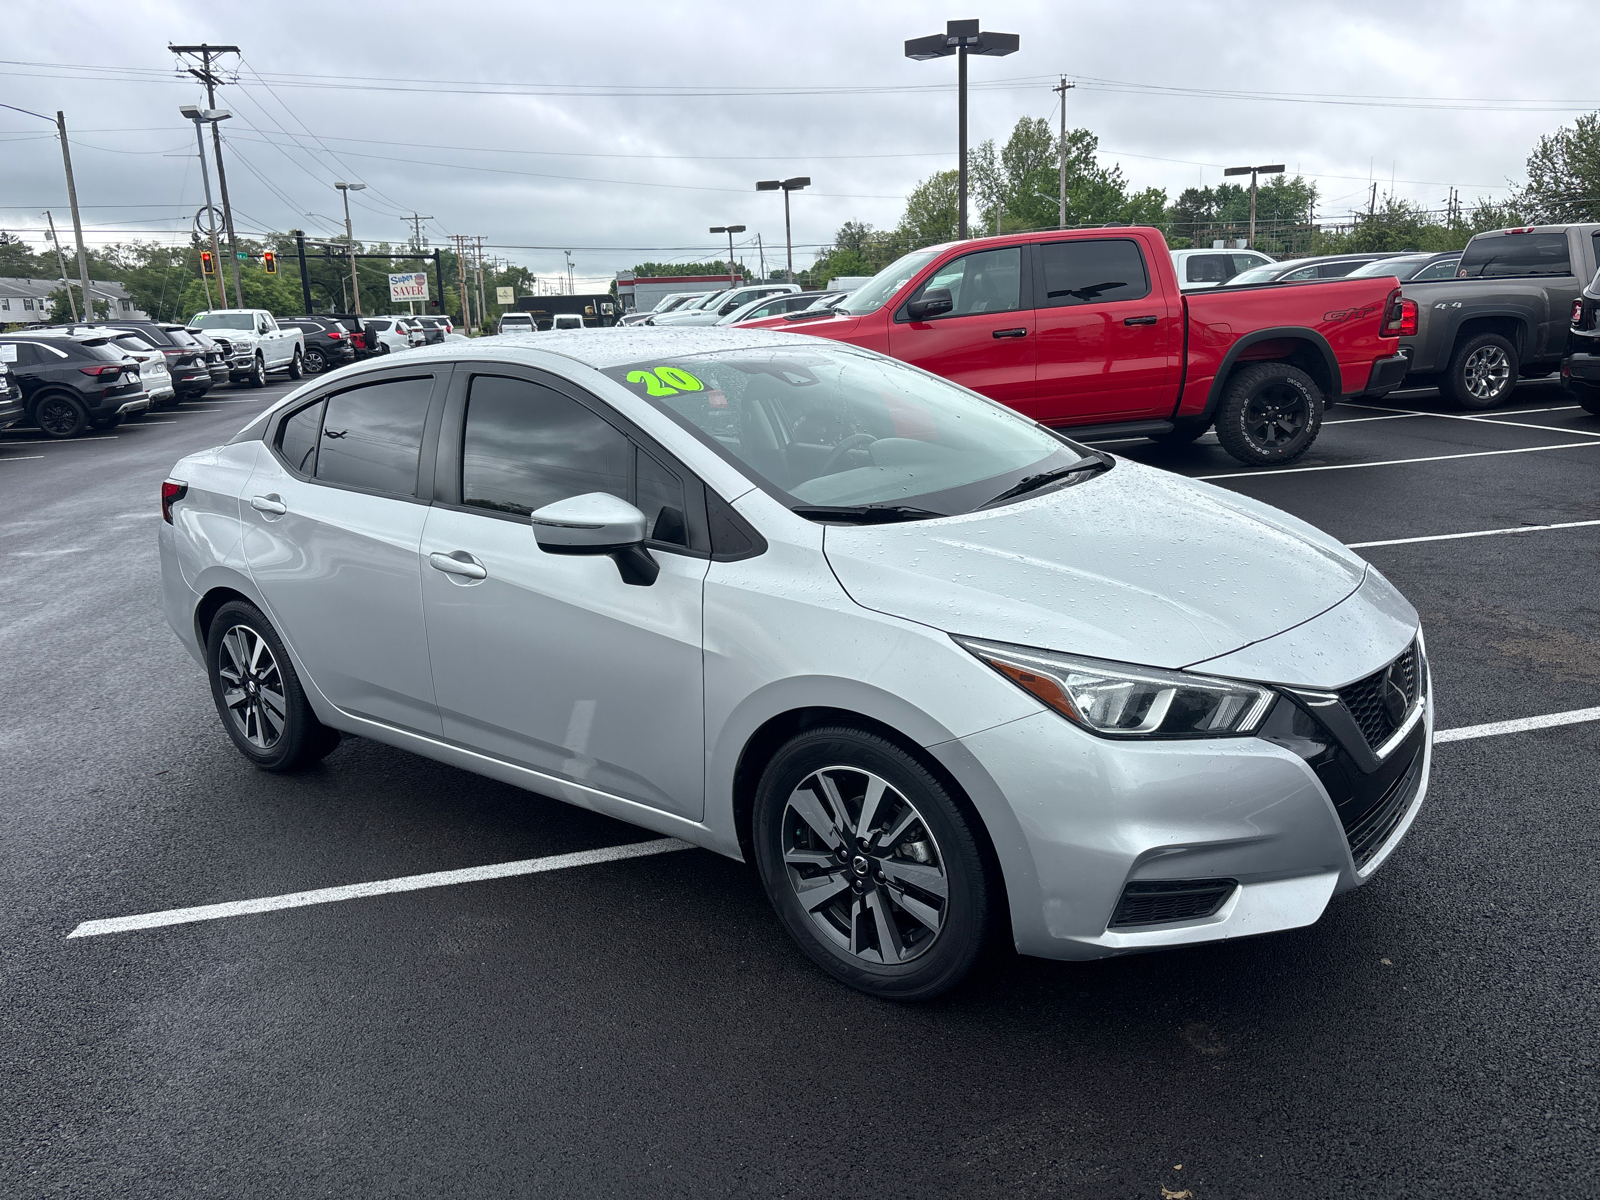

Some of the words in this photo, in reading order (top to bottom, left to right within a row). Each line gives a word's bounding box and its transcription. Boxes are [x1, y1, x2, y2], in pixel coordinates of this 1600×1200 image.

[391, 274, 413, 285] Super
[393, 286, 424, 296] SAVER
[626, 366, 705, 397] 20
